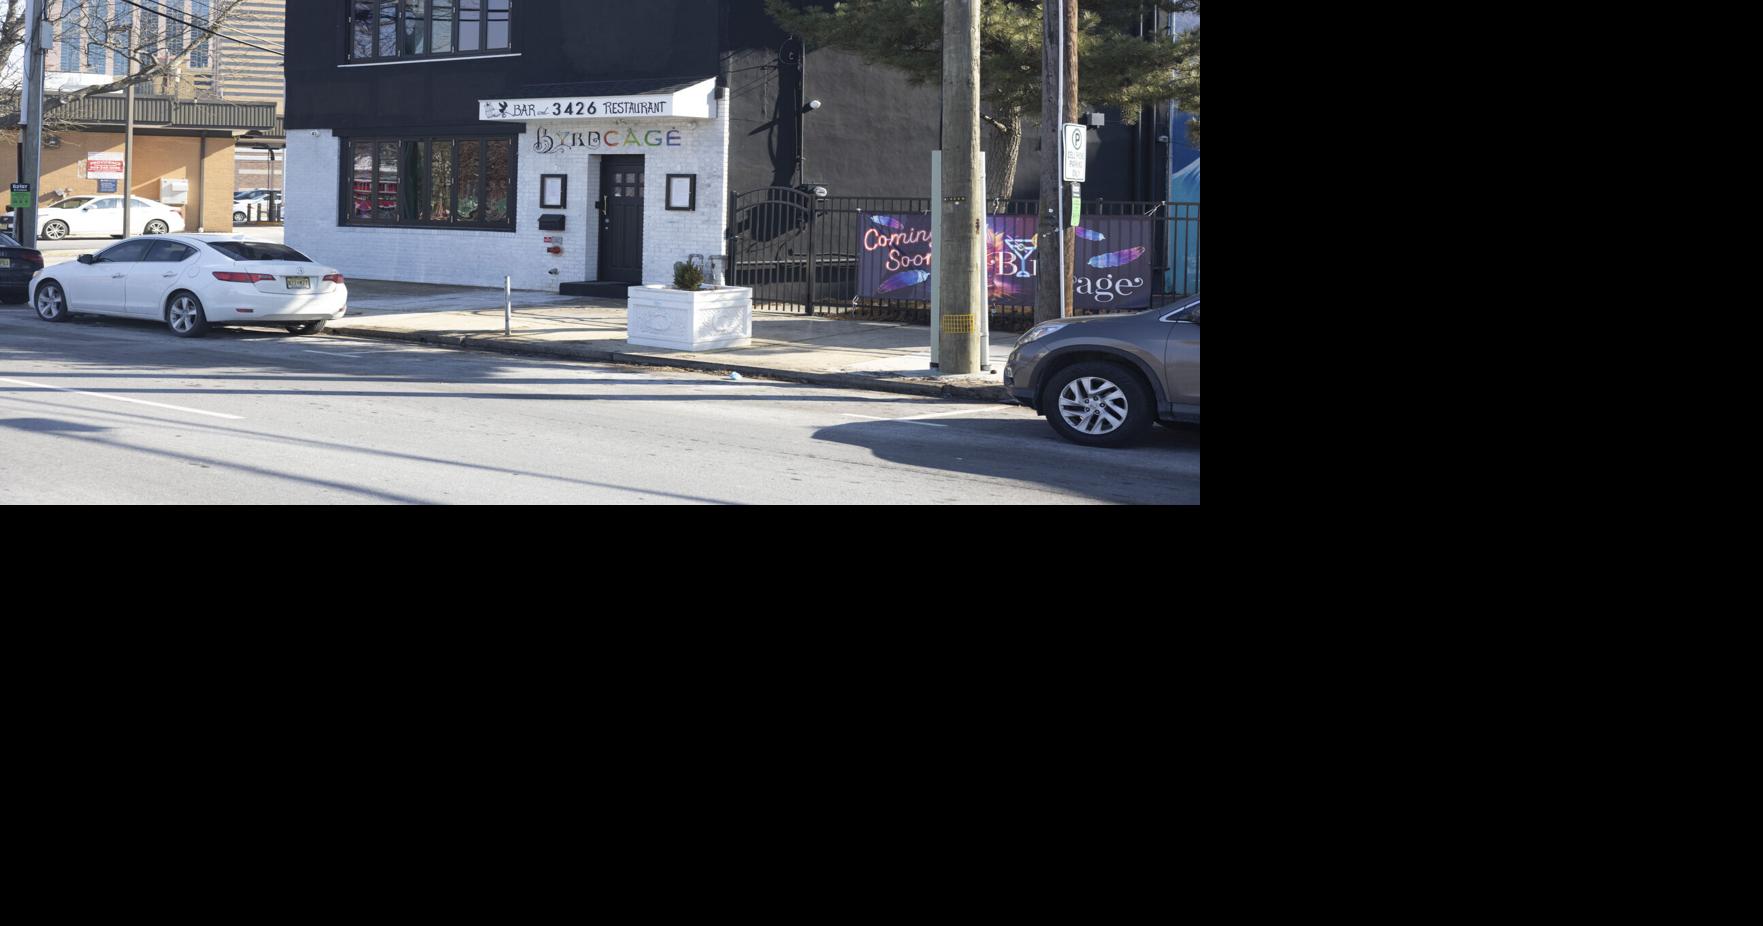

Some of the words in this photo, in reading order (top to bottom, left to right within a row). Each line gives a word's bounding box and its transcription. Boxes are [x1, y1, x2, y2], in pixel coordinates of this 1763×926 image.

[513, 104, 536, 117] BAR
[552, 101, 597, 116] 3426
[603, 101, 667, 115] RESTAURANT
[1072, 274, 1144, 302] age
